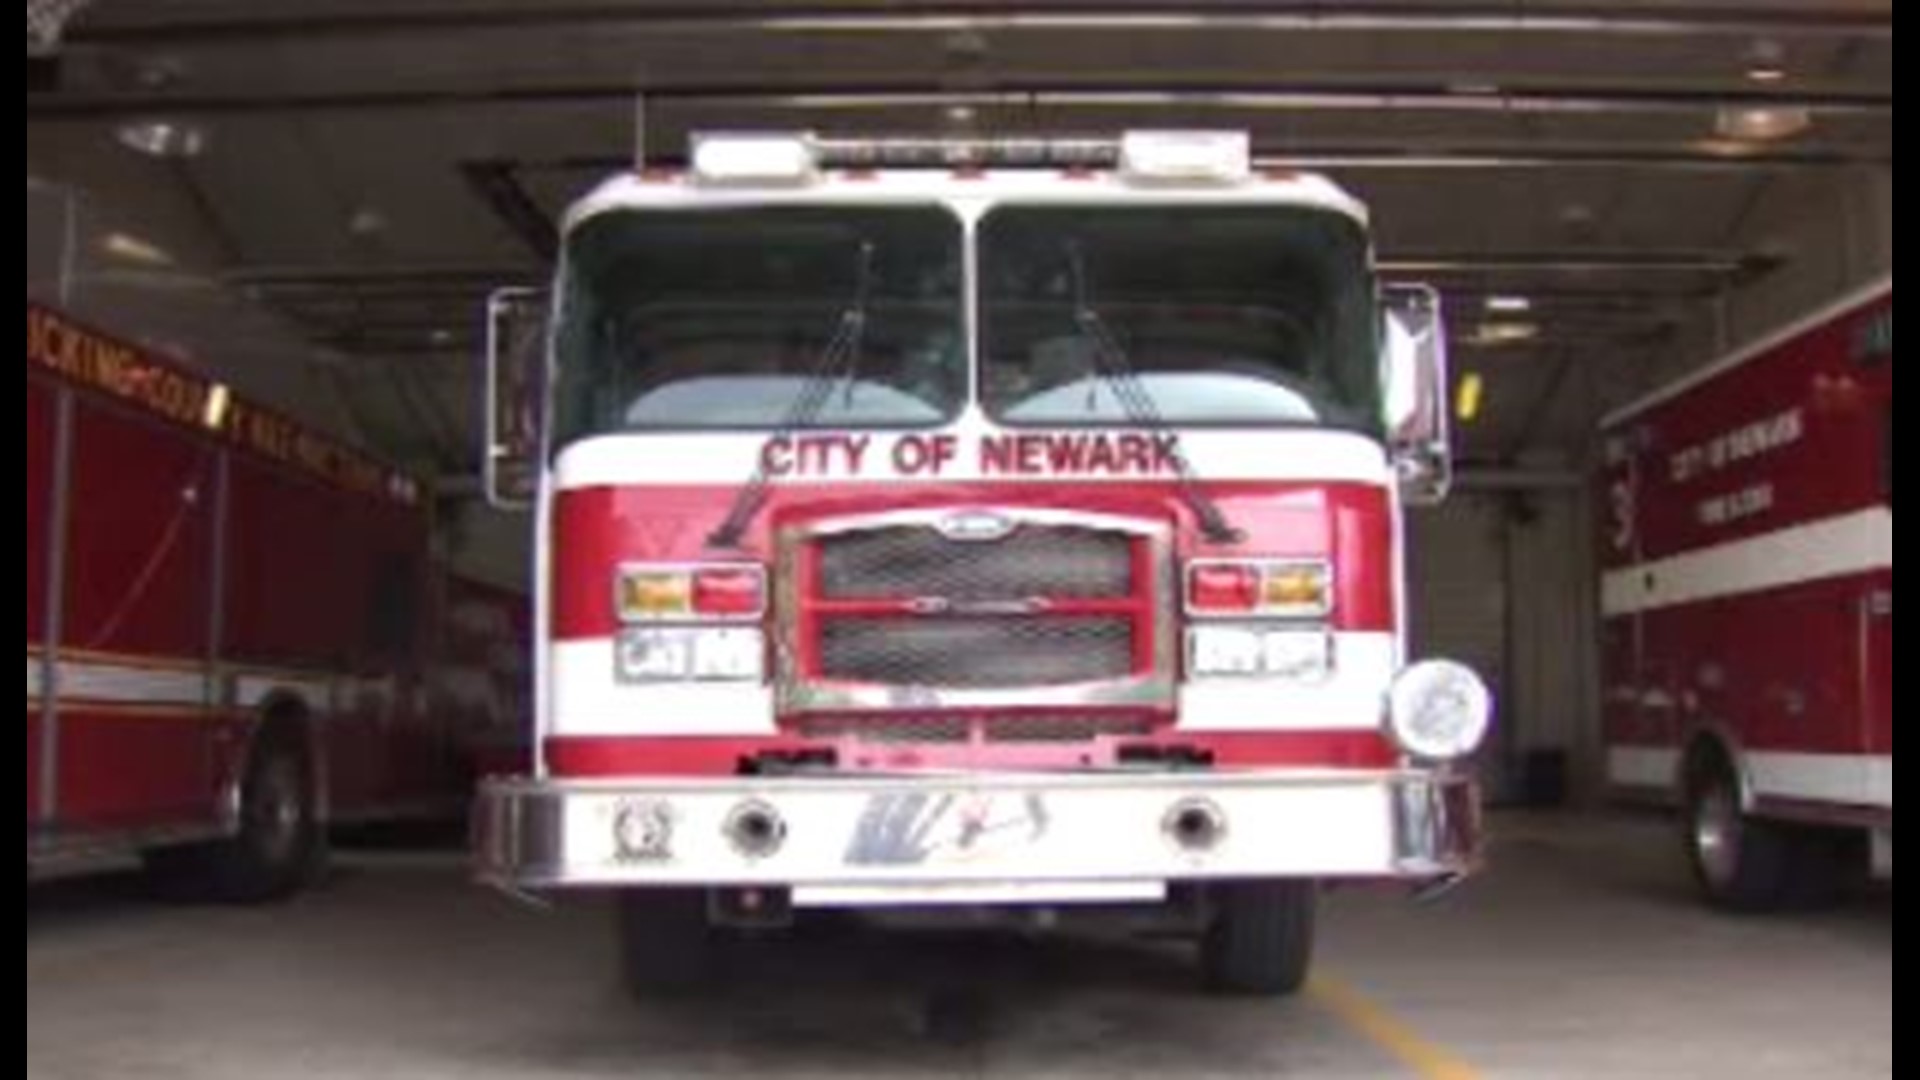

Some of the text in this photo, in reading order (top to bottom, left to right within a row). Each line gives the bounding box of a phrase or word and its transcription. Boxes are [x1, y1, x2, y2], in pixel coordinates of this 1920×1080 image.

[762, 435, 1179, 474] CITY OF NEWARK
